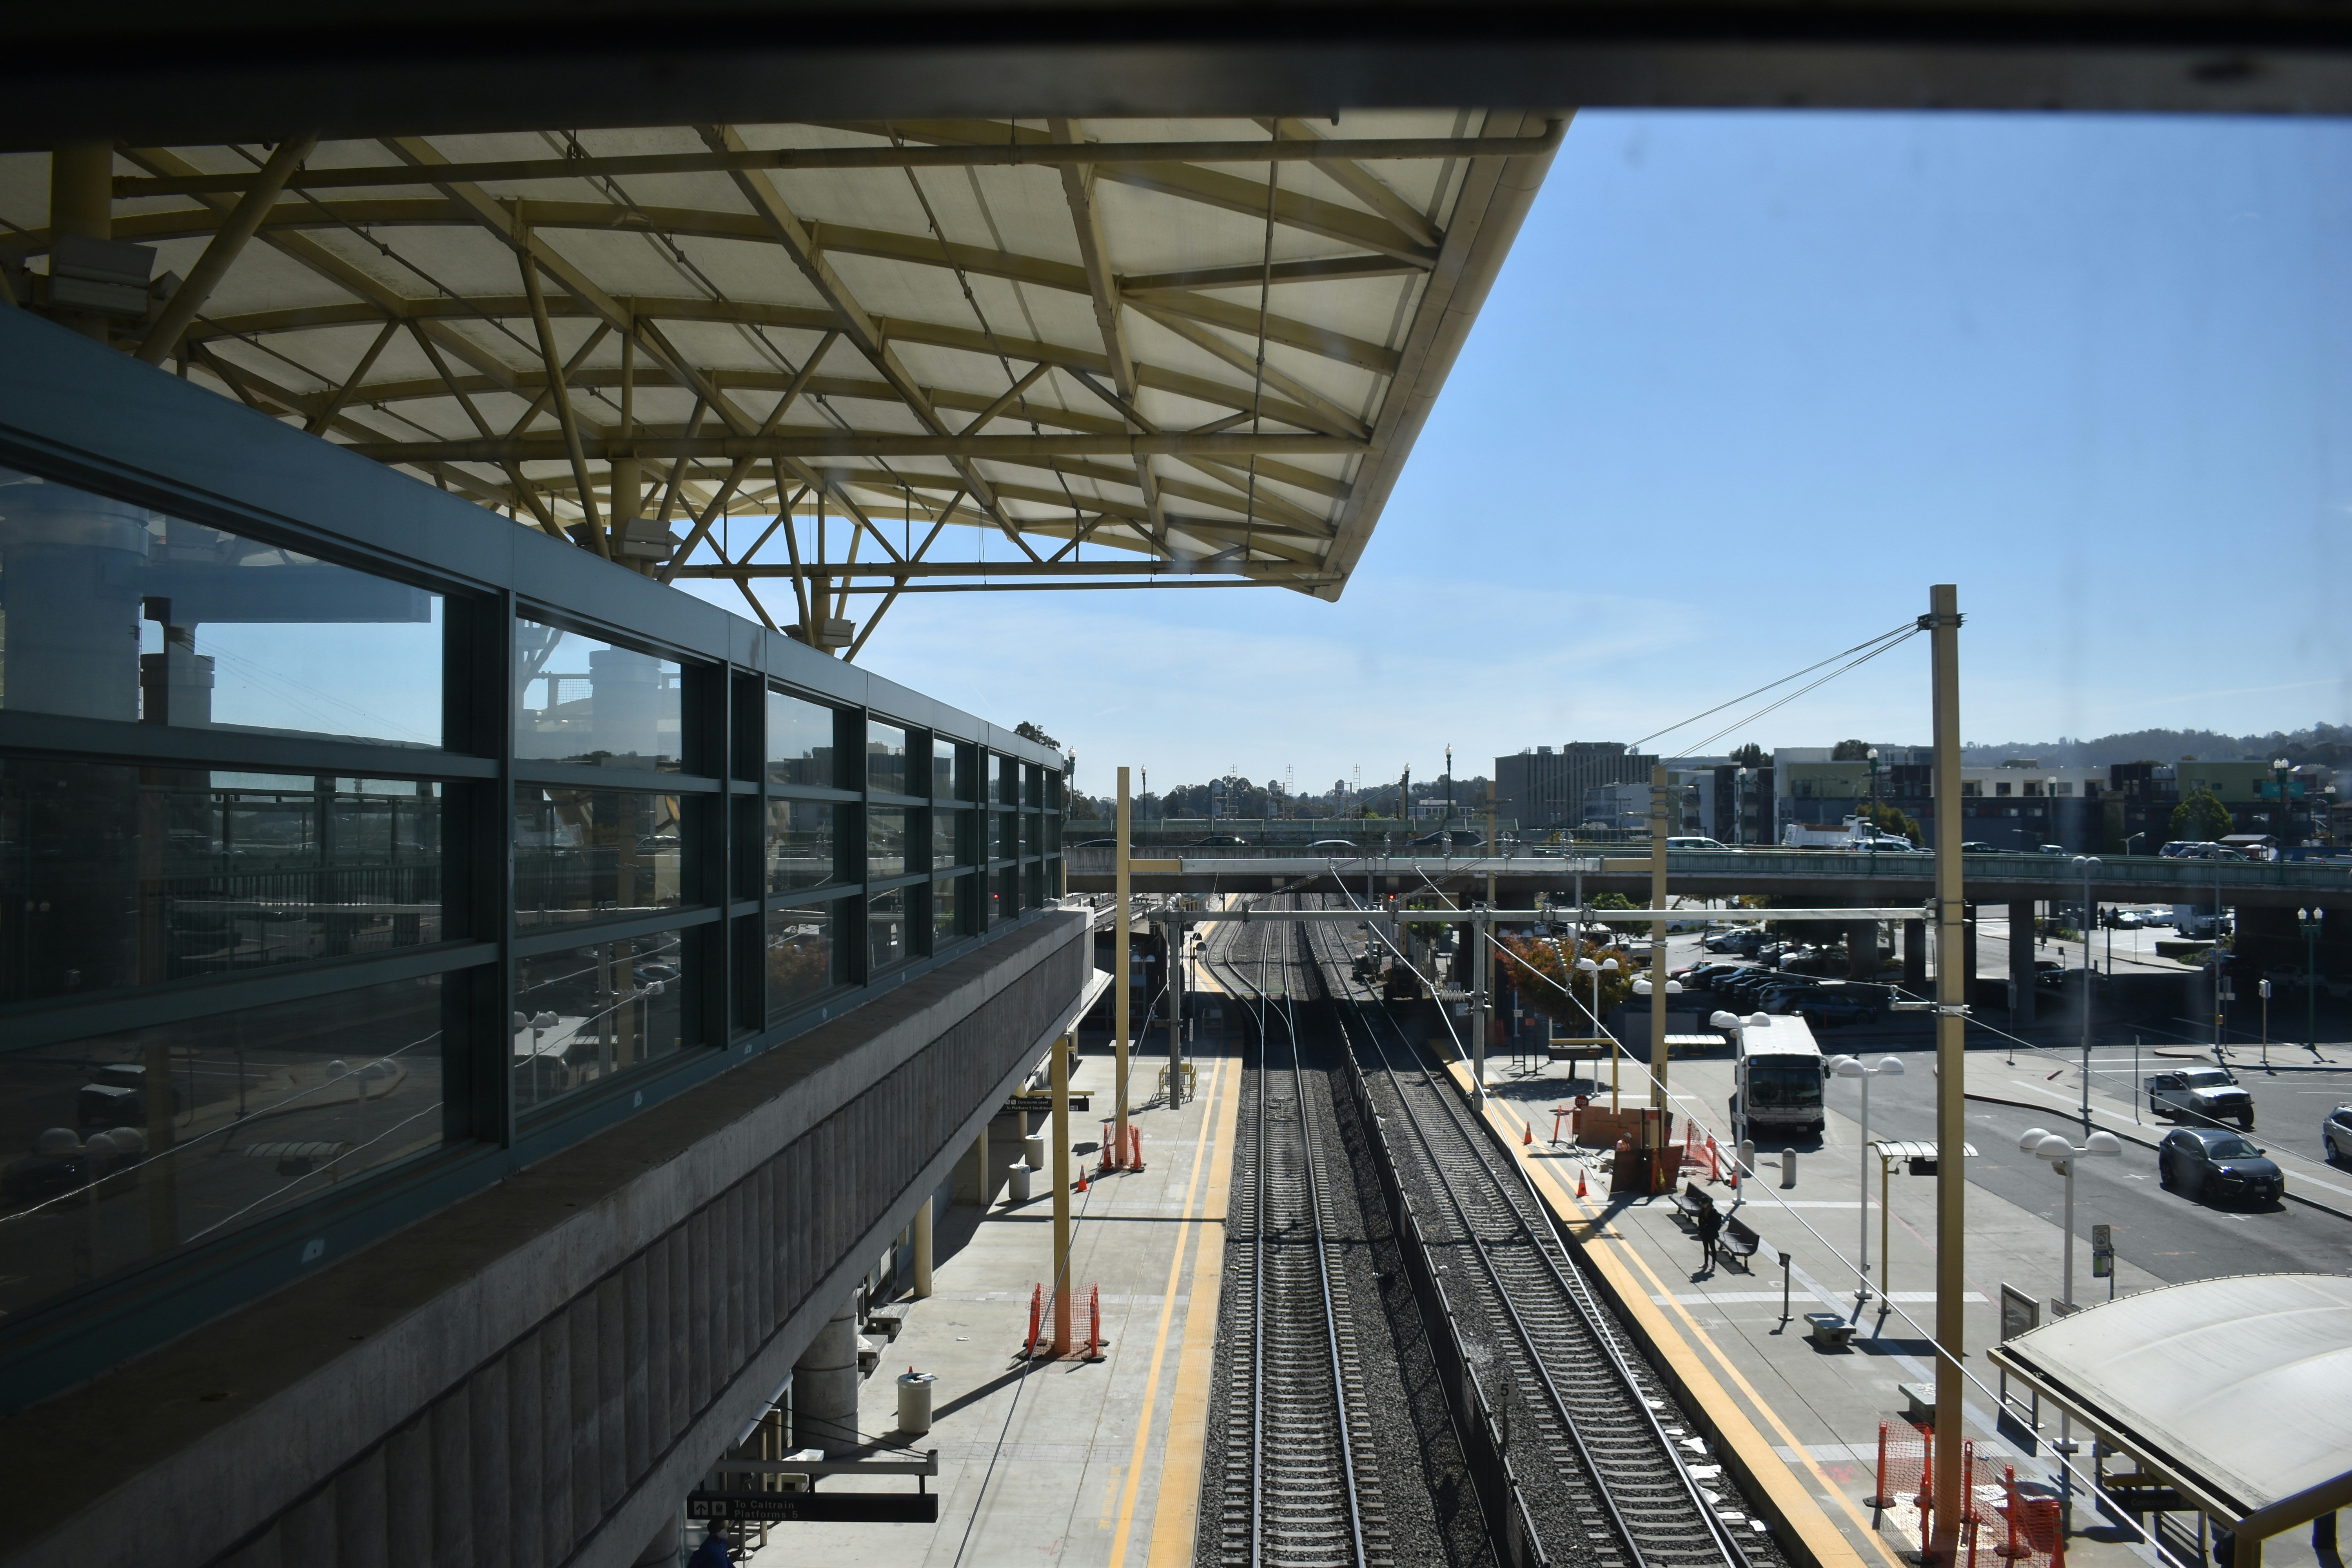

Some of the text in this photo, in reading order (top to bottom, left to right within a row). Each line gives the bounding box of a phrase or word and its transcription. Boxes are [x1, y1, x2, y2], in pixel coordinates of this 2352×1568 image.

[751, 1500, 794, 1509] Caltrain
[2131, 1498, 2176, 1506] Concourse
[735, 1510, 786, 1518] Platforms
